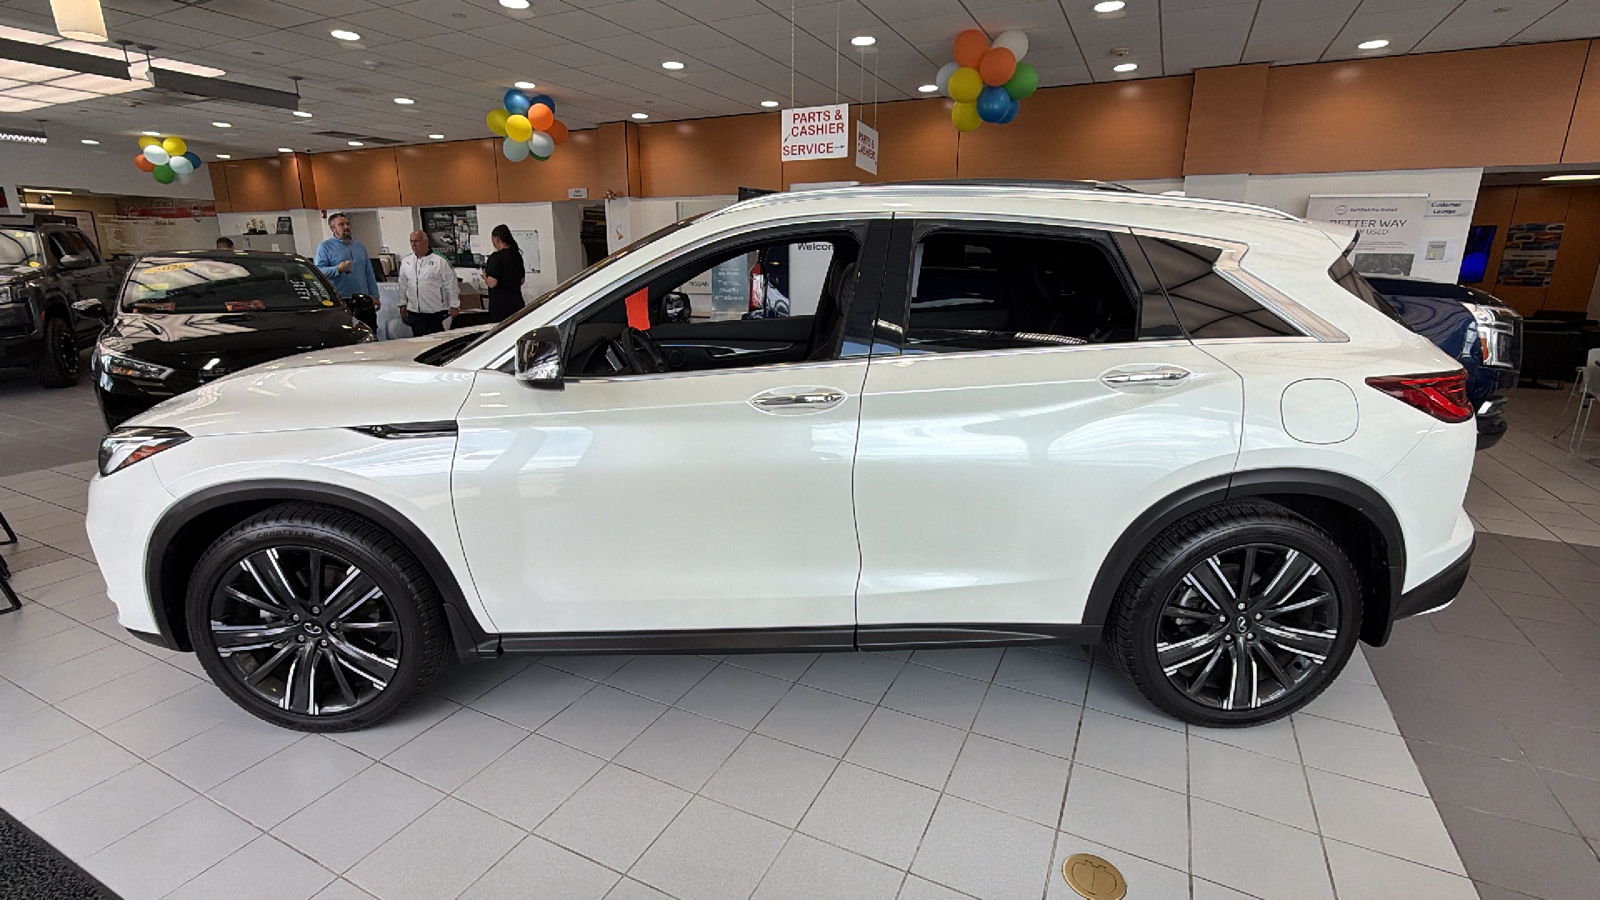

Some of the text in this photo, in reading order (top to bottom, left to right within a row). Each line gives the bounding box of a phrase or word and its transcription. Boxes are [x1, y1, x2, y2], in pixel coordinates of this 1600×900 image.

[793, 109, 843, 124] PARTS &
[791, 122, 845, 137] CASHIER
[858, 131, 871, 147] PARTS
[783, 142, 834, 156] SERVICE
[1379, 219, 1407, 228] WAY
[1366, 228, 1389, 236] USED
[256, 529, 316, 539] GOODYEAR
